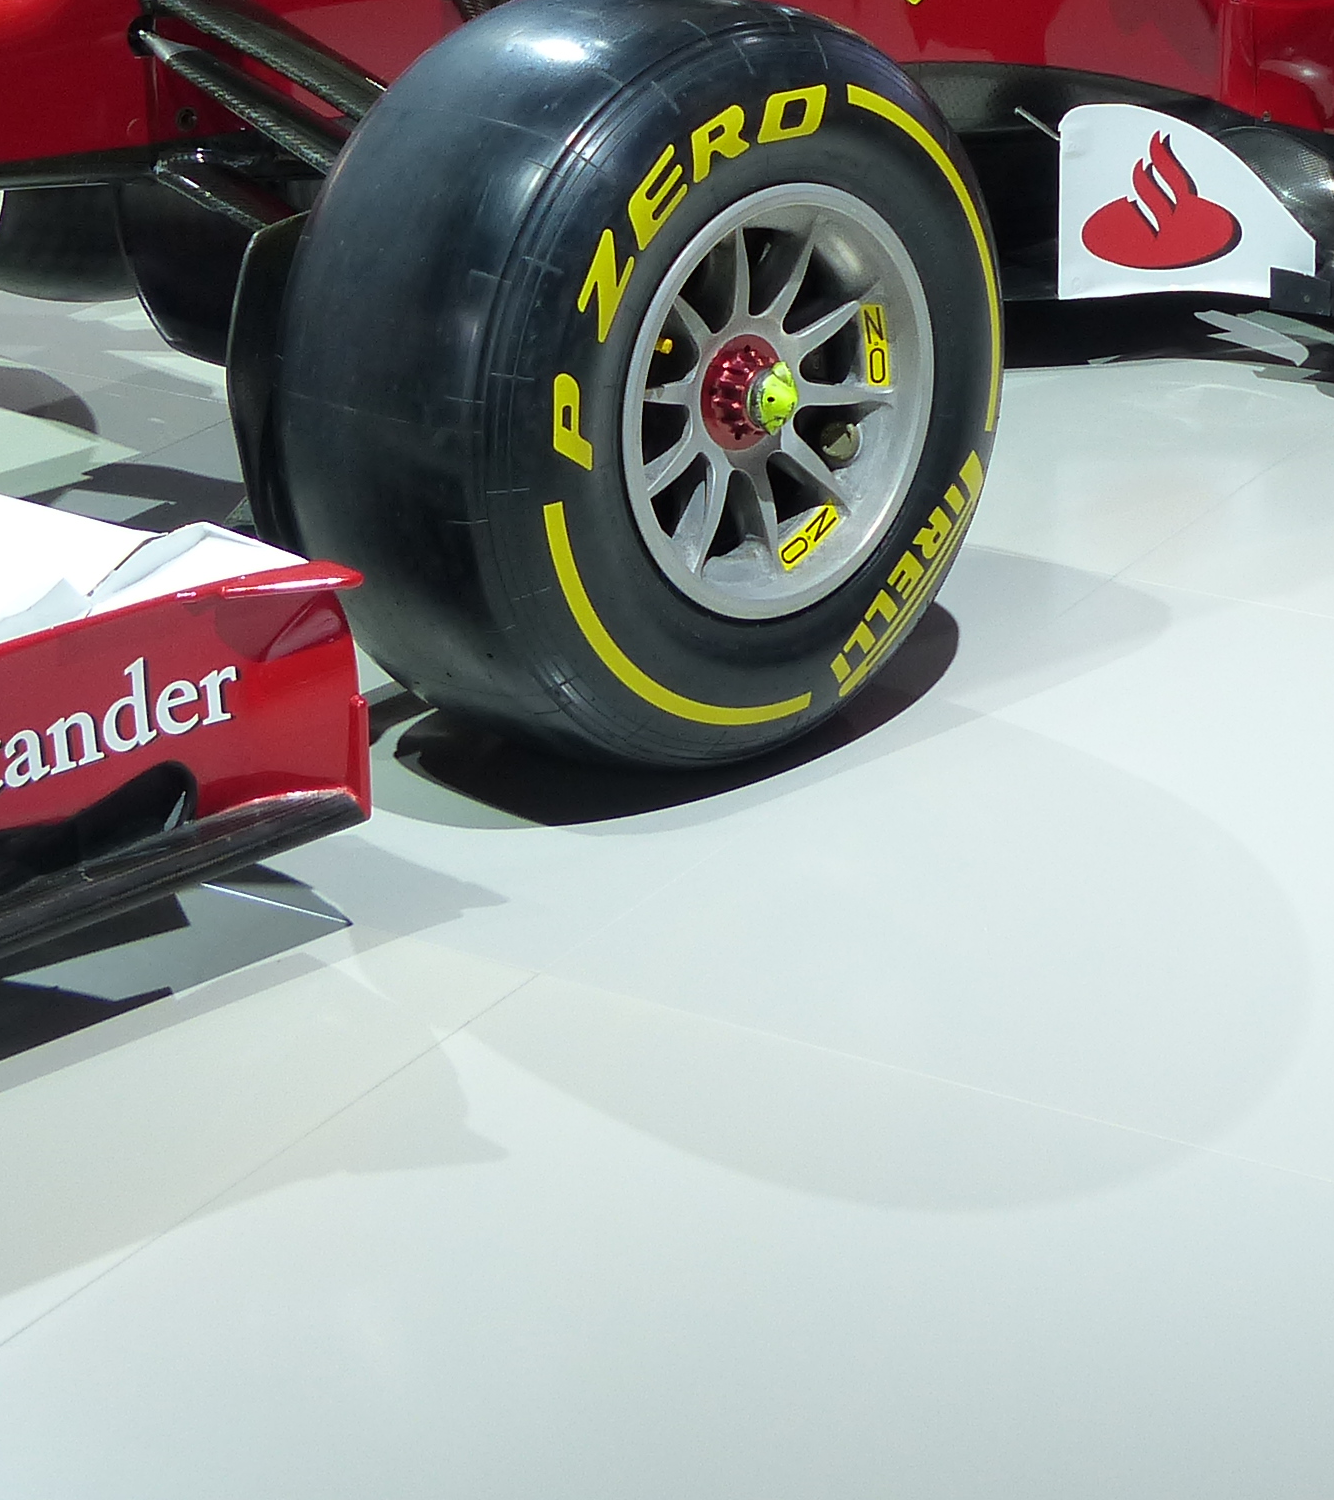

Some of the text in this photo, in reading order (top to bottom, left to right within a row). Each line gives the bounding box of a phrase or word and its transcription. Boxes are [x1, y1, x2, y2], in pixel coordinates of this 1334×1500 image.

[553, 83, 829, 471] P ZERO
[830, 450, 984, 697] PIRELLI
